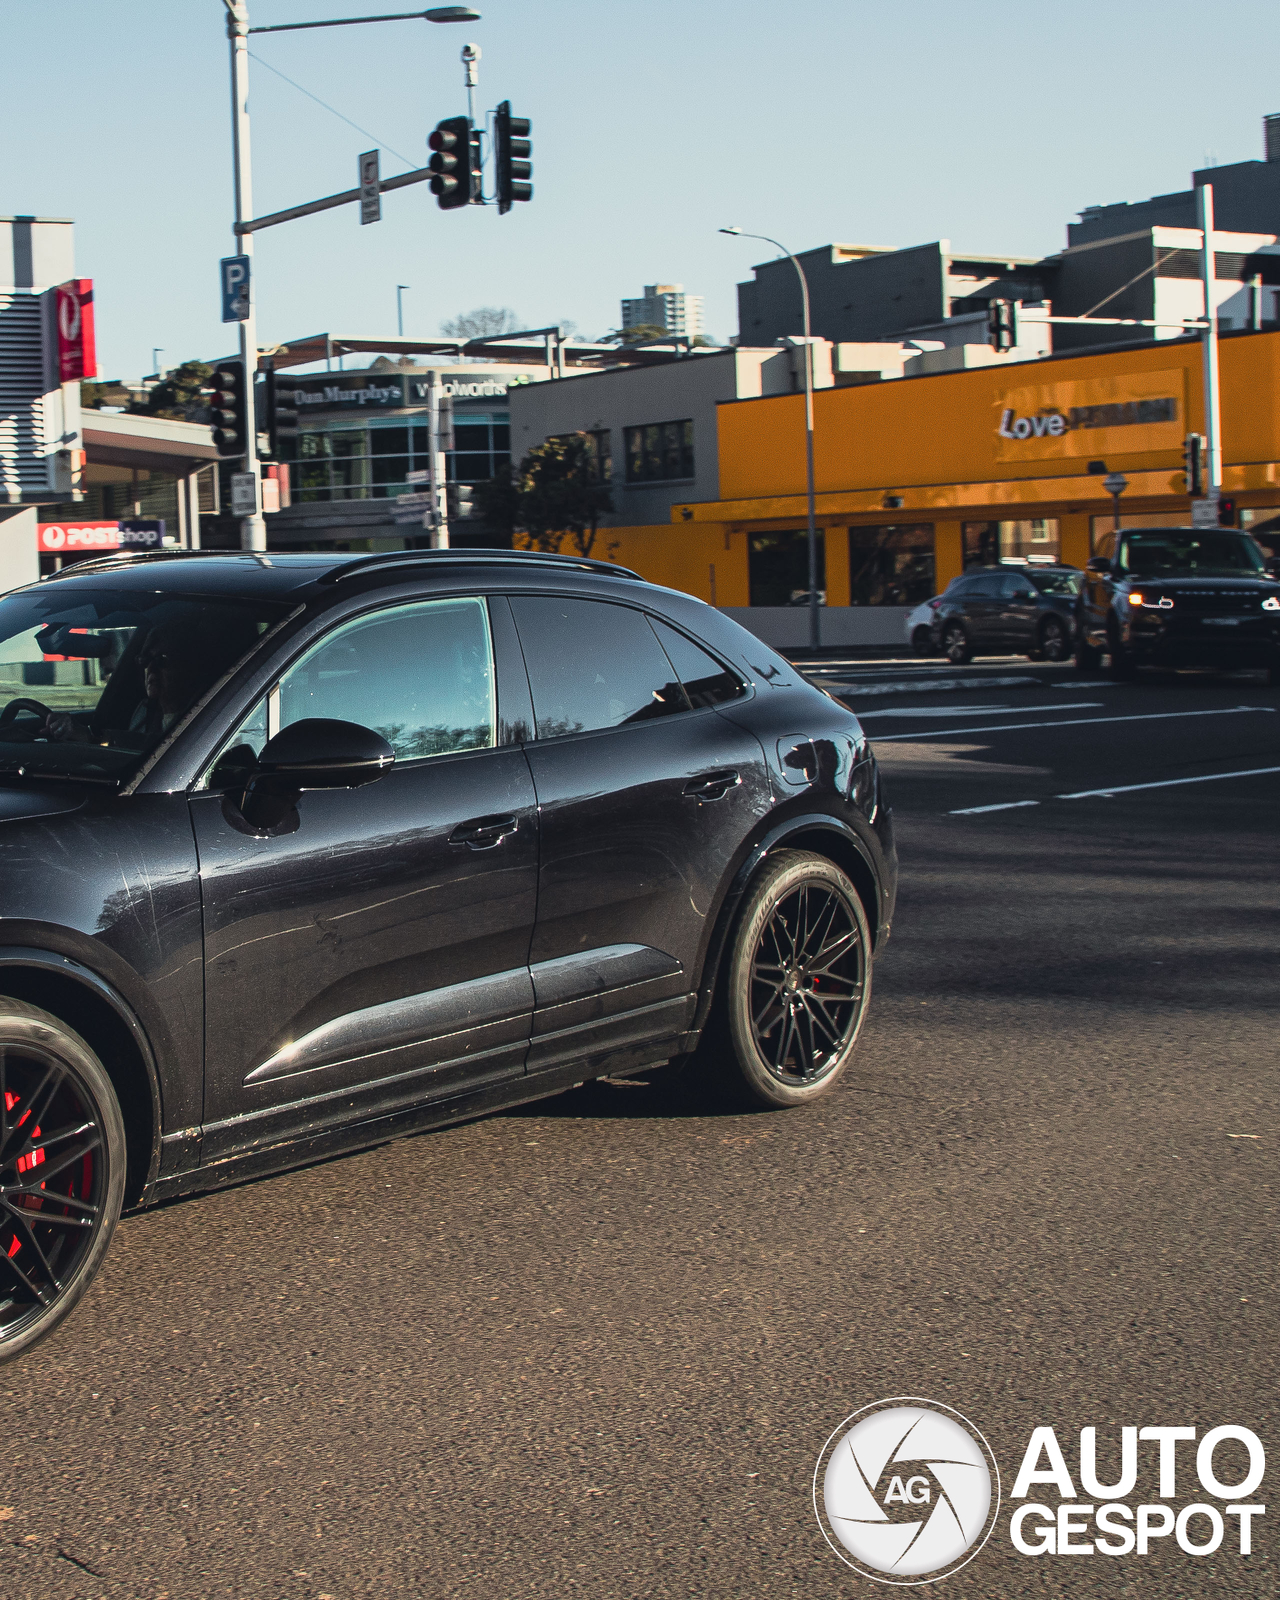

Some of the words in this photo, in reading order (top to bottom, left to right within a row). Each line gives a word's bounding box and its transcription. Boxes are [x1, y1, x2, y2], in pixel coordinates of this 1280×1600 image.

[226, 264, 245, 294] P
[323, 383, 402, 405] Murphy's
[999, 409, 1067, 440] Love
